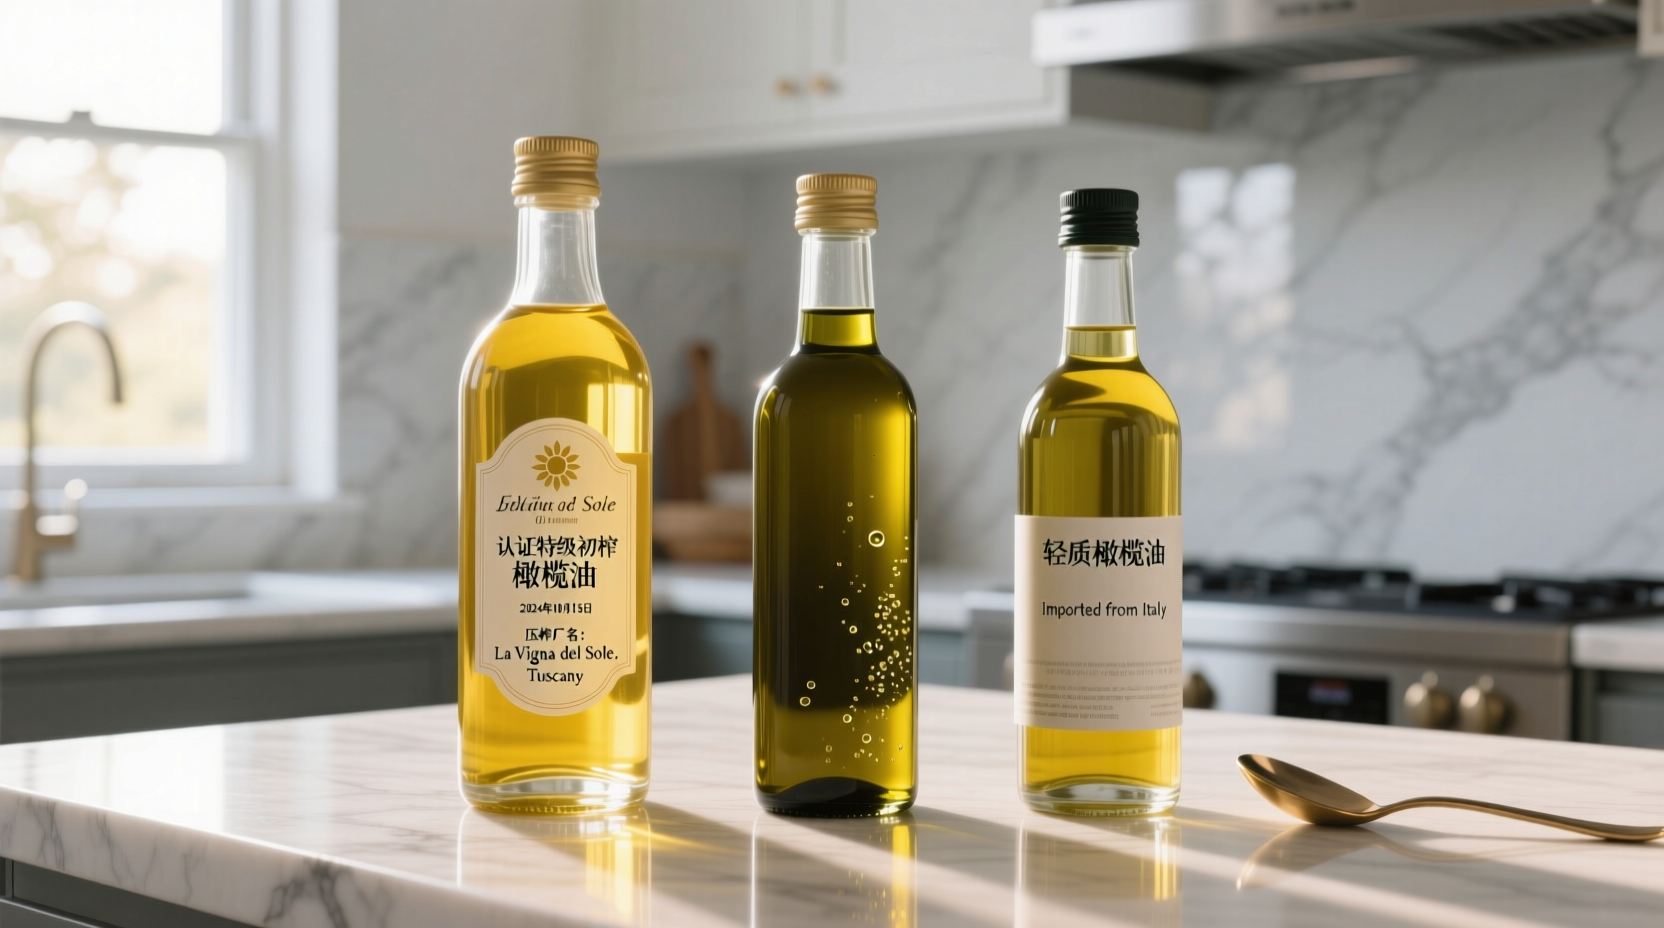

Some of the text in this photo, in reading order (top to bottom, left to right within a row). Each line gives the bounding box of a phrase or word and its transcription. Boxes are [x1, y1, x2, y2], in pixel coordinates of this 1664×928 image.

[582, 495, 616, 512] Sole
[496, 535, 618, 558] 认证特级初榨
[1042, 538, 1166, 567] 轻质橄榄油
[512, 559, 597, 589] 橄榄油
[1042, 601, 1167, 620] Imported from Italy
[494, 646, 511, 660] La
[514, 646, 556, 665] Vigna
[560, 645, 581, 660] del
[526, 667, 584, 686] Tuscany
